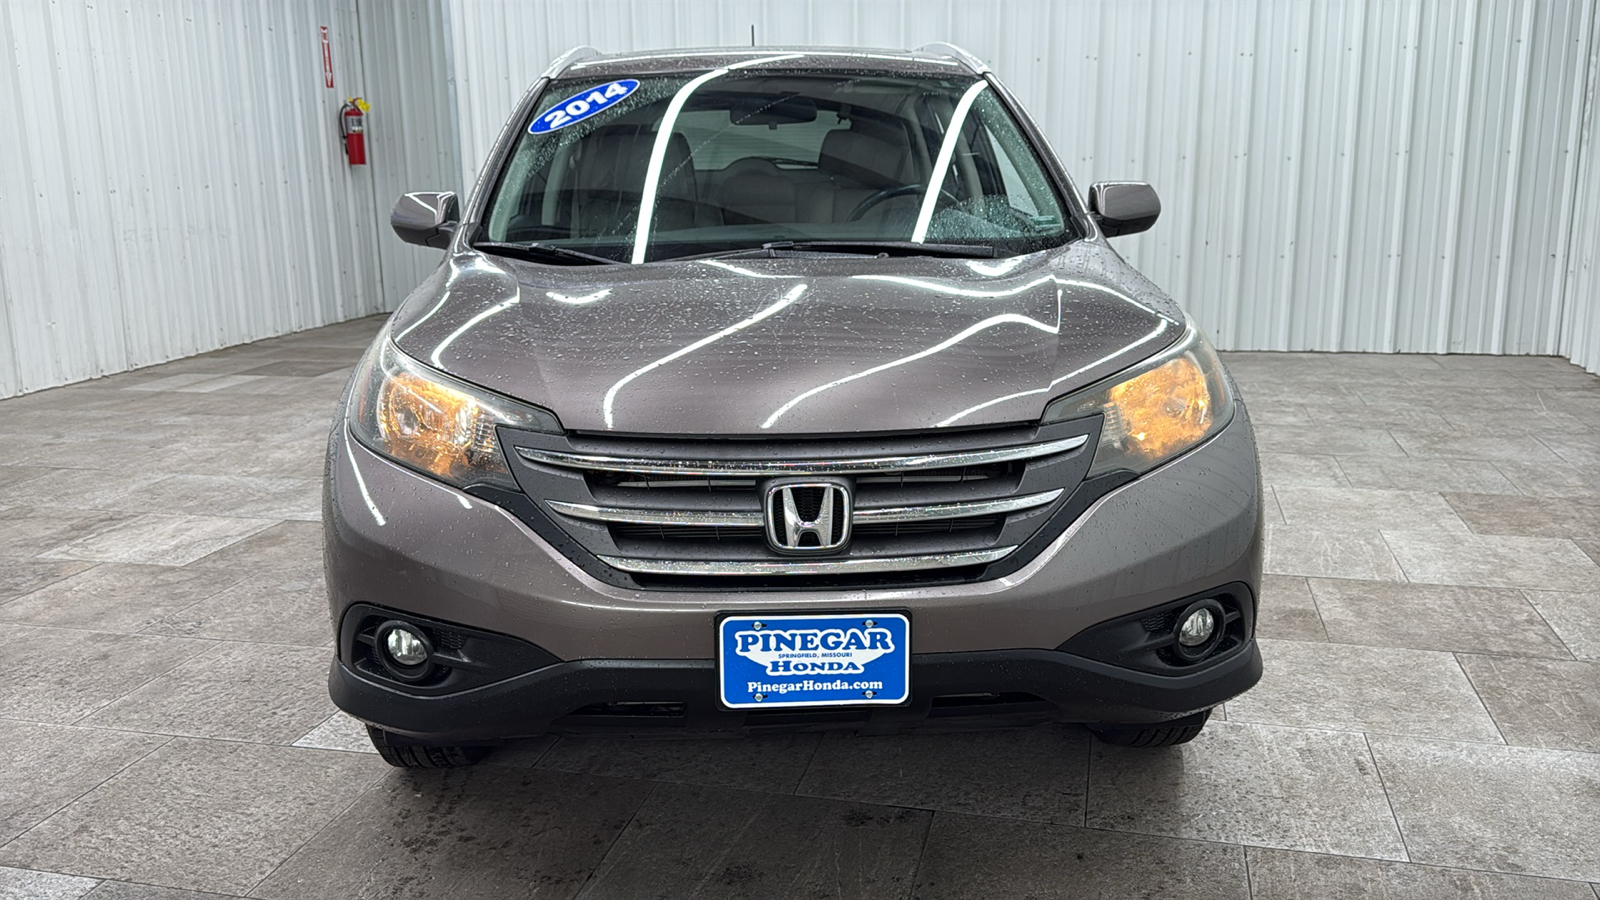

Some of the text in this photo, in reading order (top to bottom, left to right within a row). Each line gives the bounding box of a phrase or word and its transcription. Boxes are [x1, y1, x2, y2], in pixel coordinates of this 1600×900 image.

[544, 82, 629, 129] 2014
[738, 630, 892, 653] PINEGAR
[769, 660, 861, 673] HONDA
[747, 680, 883, 694] PinegarHonda.com
